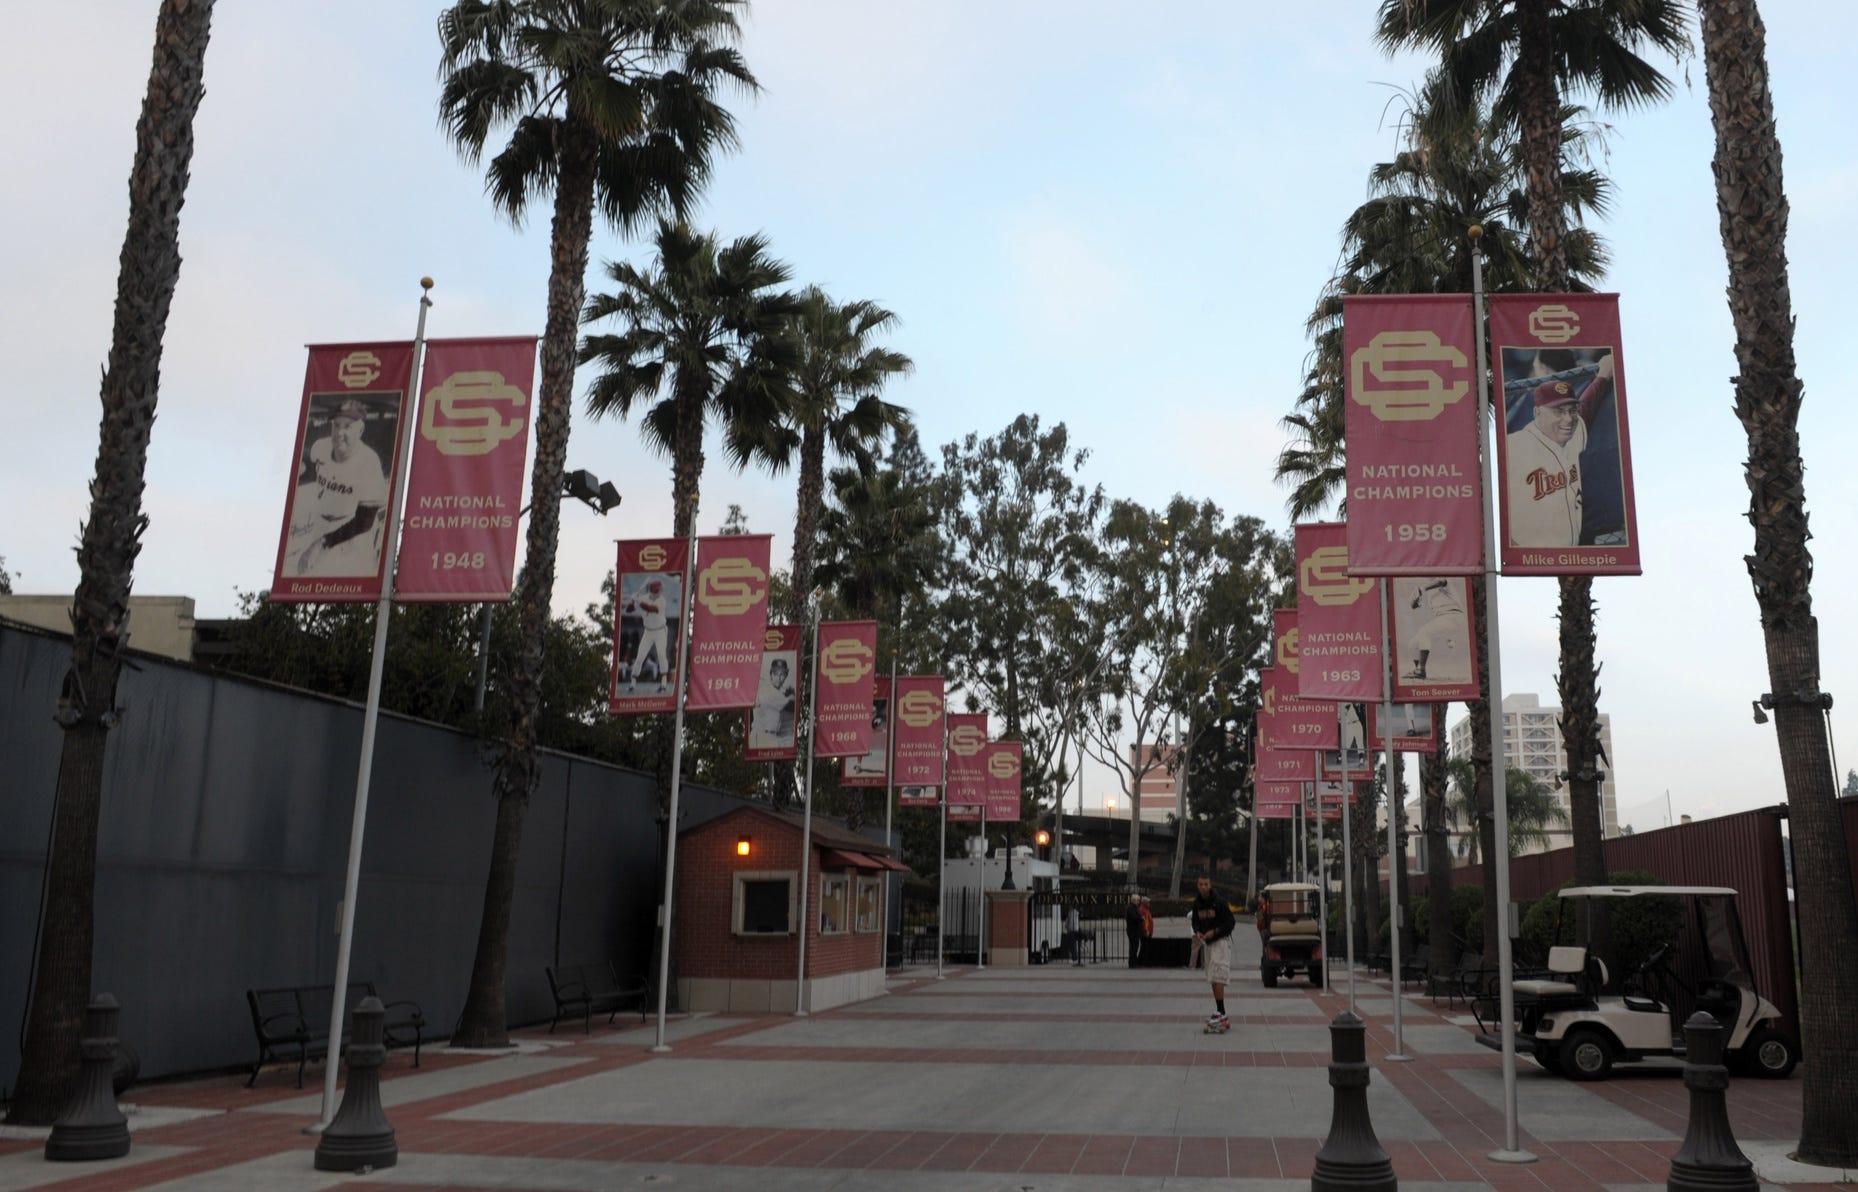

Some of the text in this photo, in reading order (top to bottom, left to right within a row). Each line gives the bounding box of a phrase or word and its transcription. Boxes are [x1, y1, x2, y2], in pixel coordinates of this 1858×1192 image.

[1362, 464, 1463, 478] NATIONAL
[1354, 485, 1474, 500] CHAMPIONS
[419, 496, 506, 509] NATIONAL
[409, 515, 513, 529] CHAMPIONS
[1384, 524, 1447, 542] 1958
[431, 552, 486, 570] 1948
[1522, 553, 1617, 568] Mike Gillespie
[291, 583, 362, 594] Rod Dedeaux
[1308, 631, 1371, 643] NATIONAL
[700, 641, 756, 651] NATIONAL
[1303, 645, 1378, 657] CHAMPIONS
[693, 653, 760, 664] CHAMPIONS
[1322, 670, 1361, 683] 1963
[706, 678, 740, 691] 1961
[1411, 688, 1461, 697] Tom Seaver
[619, 700, 636, 709] Mark
[823, 703, 867, 711] NATIONAL
[1278, 705, 1335, 713] CHAMPIONS
[819, 712, 870, 722] CHAMPIONS
[1292, 724, 1322, 734] 1970
[831, 732, 857, 742] 1968
[908, 766, 930, 774] 1972
[1278, 761, 1301, 769] 1971
[1038, 894, 1098, 905] DEDEAUX
